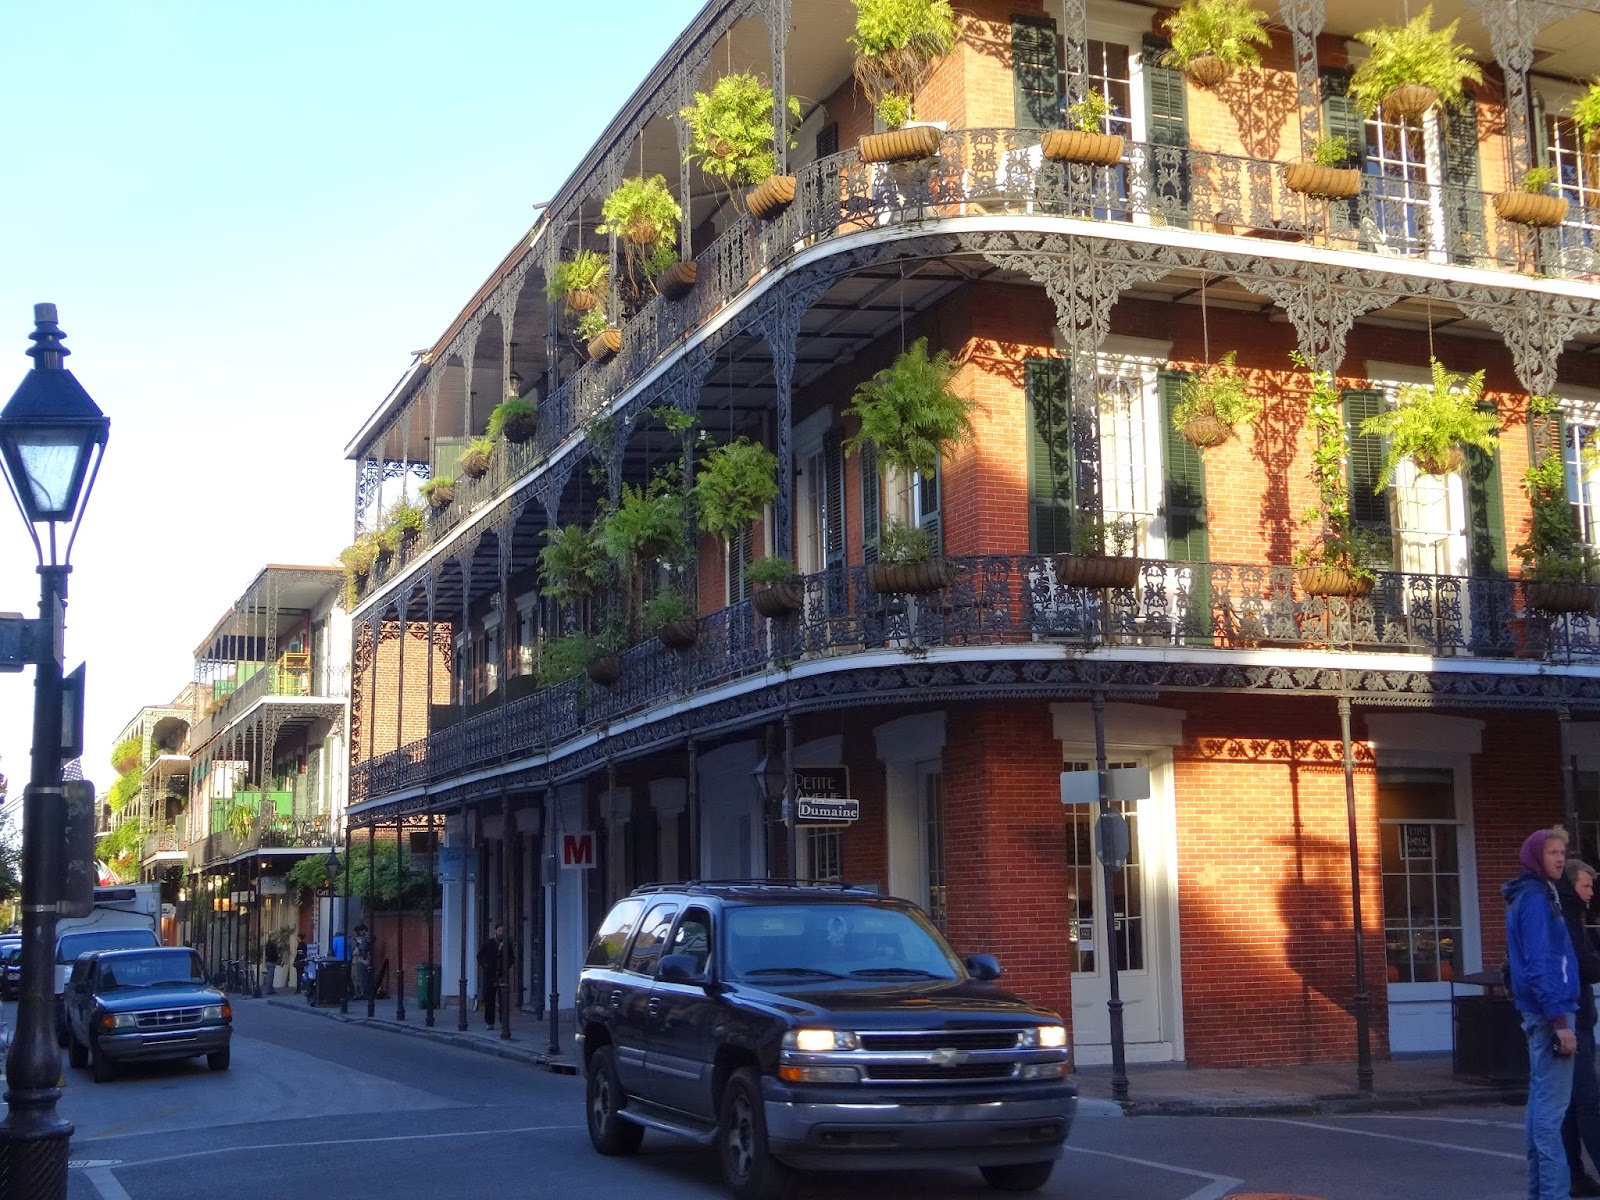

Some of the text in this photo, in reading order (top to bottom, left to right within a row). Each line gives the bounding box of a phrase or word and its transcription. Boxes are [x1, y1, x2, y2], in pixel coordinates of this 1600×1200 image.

[794, 774, 836, 789] PETITE
[800, 805, 857, 817] Dumaine
[564, 835, 592, 864] M
